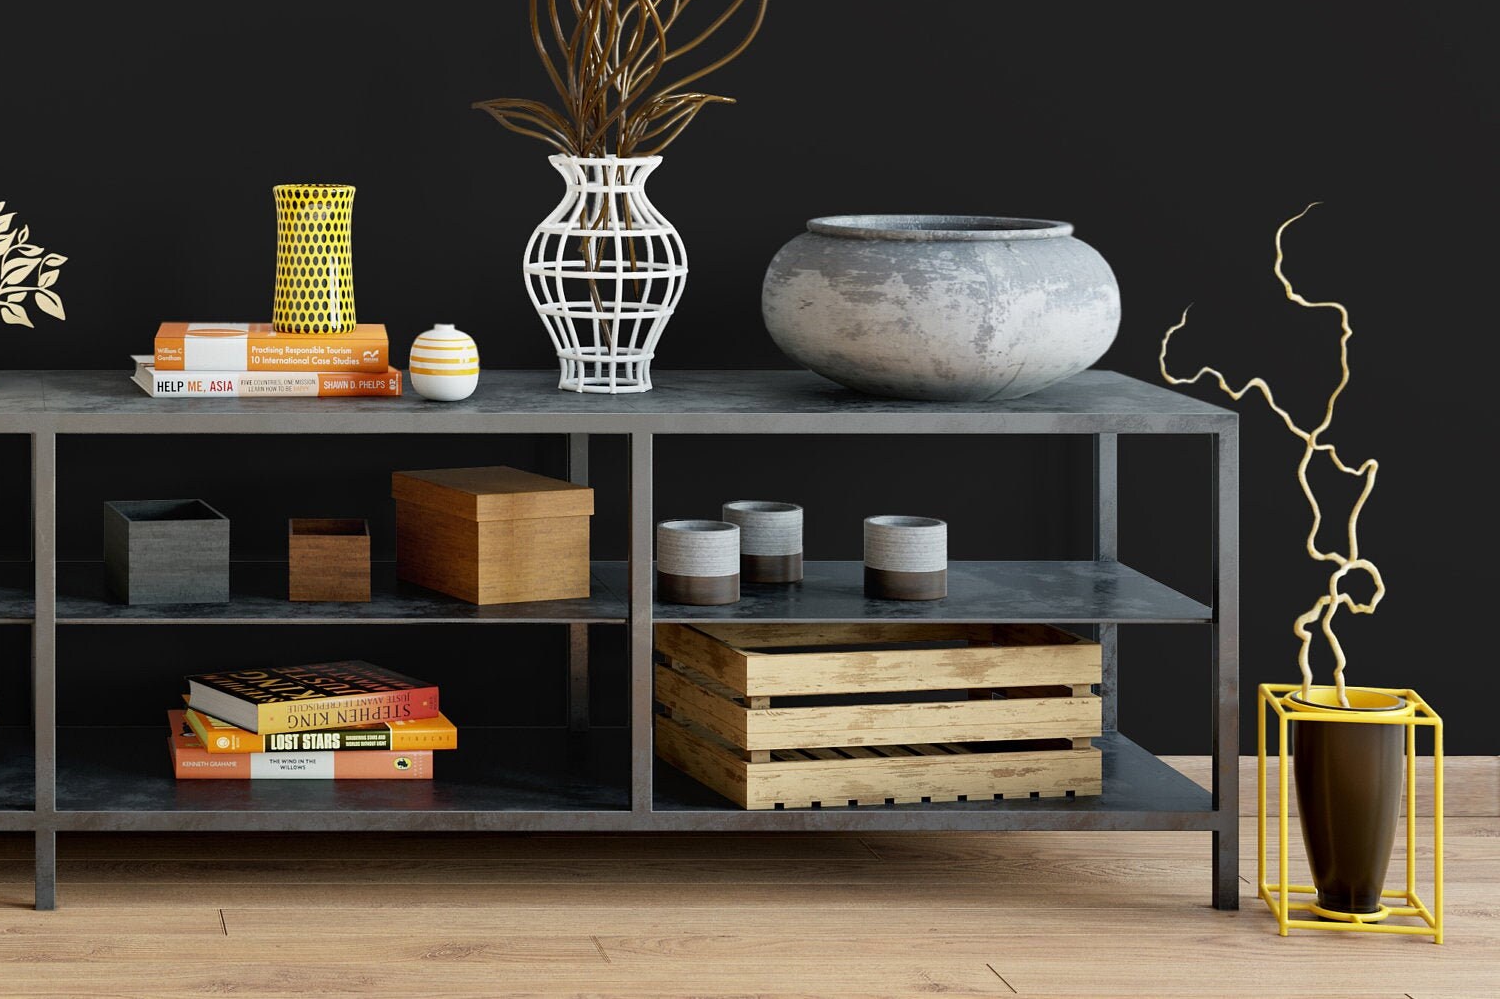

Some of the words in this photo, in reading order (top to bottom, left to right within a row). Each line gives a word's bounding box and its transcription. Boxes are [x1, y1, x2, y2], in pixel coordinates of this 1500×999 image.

[251, 346, 284, 355] Practising
[285, 346, 325, 355] Responsible
[326, 346, 352, 354] Tourism
[251, 355, 261, 364] 10
[262, 356, 310, 364] International
[311, 356, 330, 365] Case
[332, 356, 360, 365] Studies
[157, 381, 184, 392] HELP
[187, 381, 206, 393] ME,
[209, 381, 234, 392] ASIA
[323, 380, 348, 389] SHAWN
[350, 380, 357, 389] D.
[358, 380, 385, 389] PHELPS
[355, 696, 384, 707] AVANT
[387, 692, 411, 703] JUSTE
[337, 703, 411, 724] STEPHEN
[287, 711, 329, 730] KING
[270, 733, 300, 751] LOST
[302, 733, 341, 750] STARS
